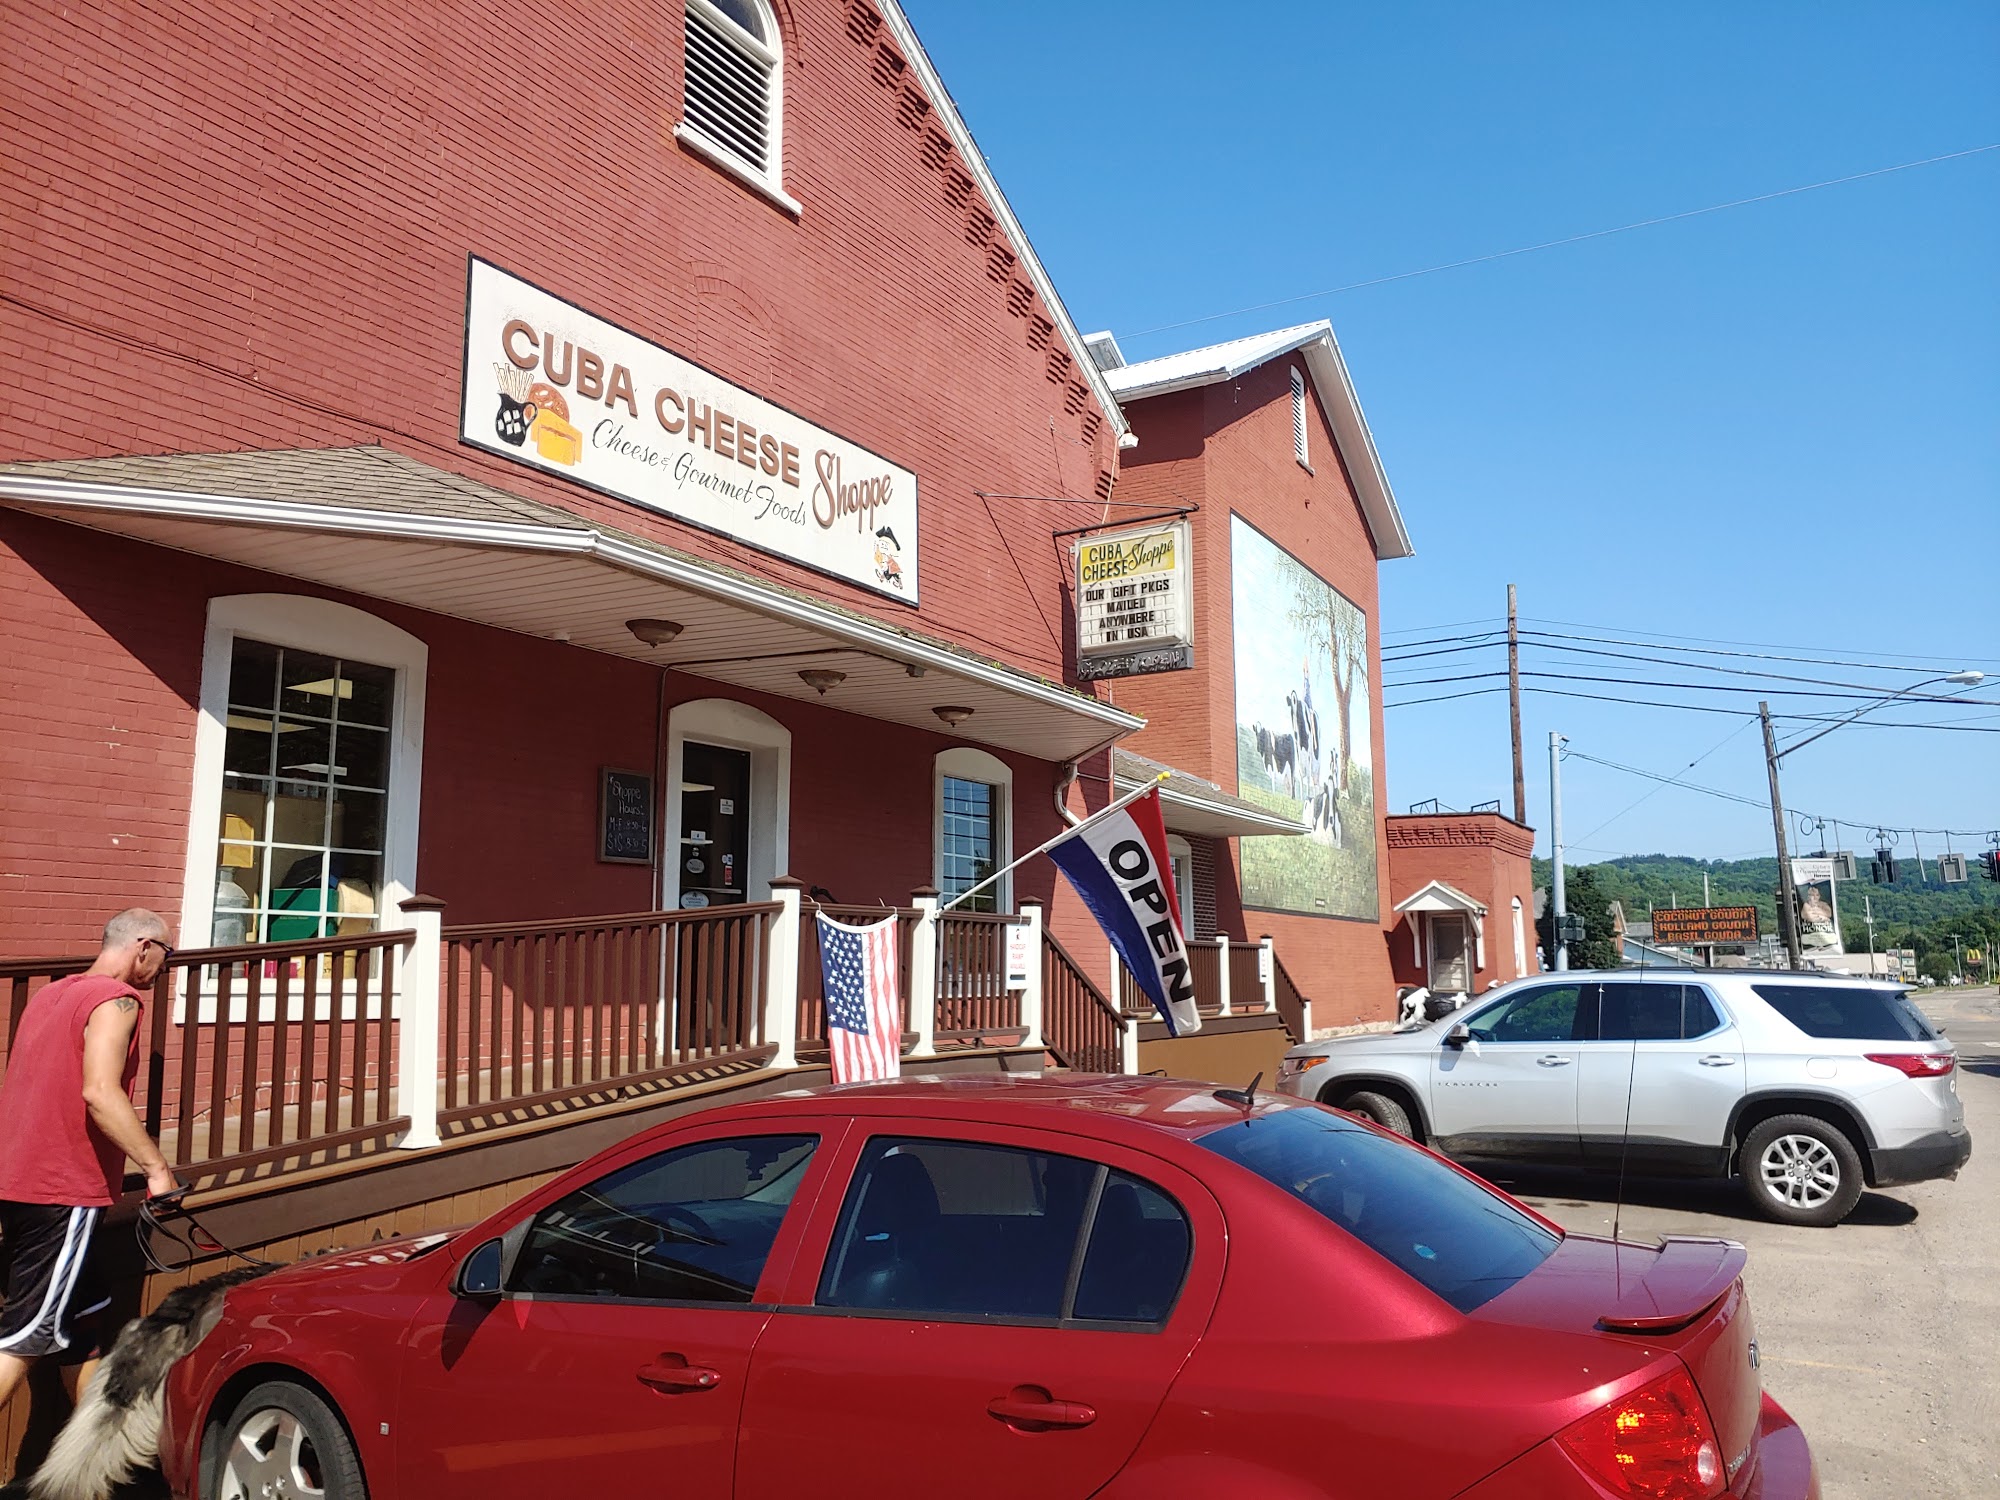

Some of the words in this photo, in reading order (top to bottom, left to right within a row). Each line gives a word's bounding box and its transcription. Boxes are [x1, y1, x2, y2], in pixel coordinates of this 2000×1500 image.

[502, 319, 638, 418] CUBA
[655, 387, 801, 488] CHEESE
[812, 448, 893, 534] Shoppe
[591, 418, 660, 468] Cheese
[673, 452, 754, 505] Gourmet
[754, 485, 807, 527] Foods
[1090, 543, 1122, 562] CUBA
[1128, 540, 1173, 570] Shoppe
[1083, 560, 1127, 581] CHEESE
[1086, 589, 1105, 602] OUR
[1112, 584, 1137, 598] GIFT
[1141, 579, 1170, 594] PKGS
[1106, 598, 1147, 613] MAILED
[1099, 610, 1155, 629] ANYWHERE
[1106, 630, 1119, 642] IN
[1127, 626, 1149, 639] USA
[612, 781, 641, 803] Shoppe
[1108, 839, 1194, 1004] OPEN
[1656, 911, 1706, 921] COCONUT
[1709, 910, 1747, 920] GOUDA
[1660, 921, 1709, 931] HOLLAND
[1711, 920, 1750, 930] GOUDA
[1667, 931, 1701, 941] BASIL
[1704, 930, 1742, 940] GOUDA
[1802, 924, 1834, 933] HONOR
